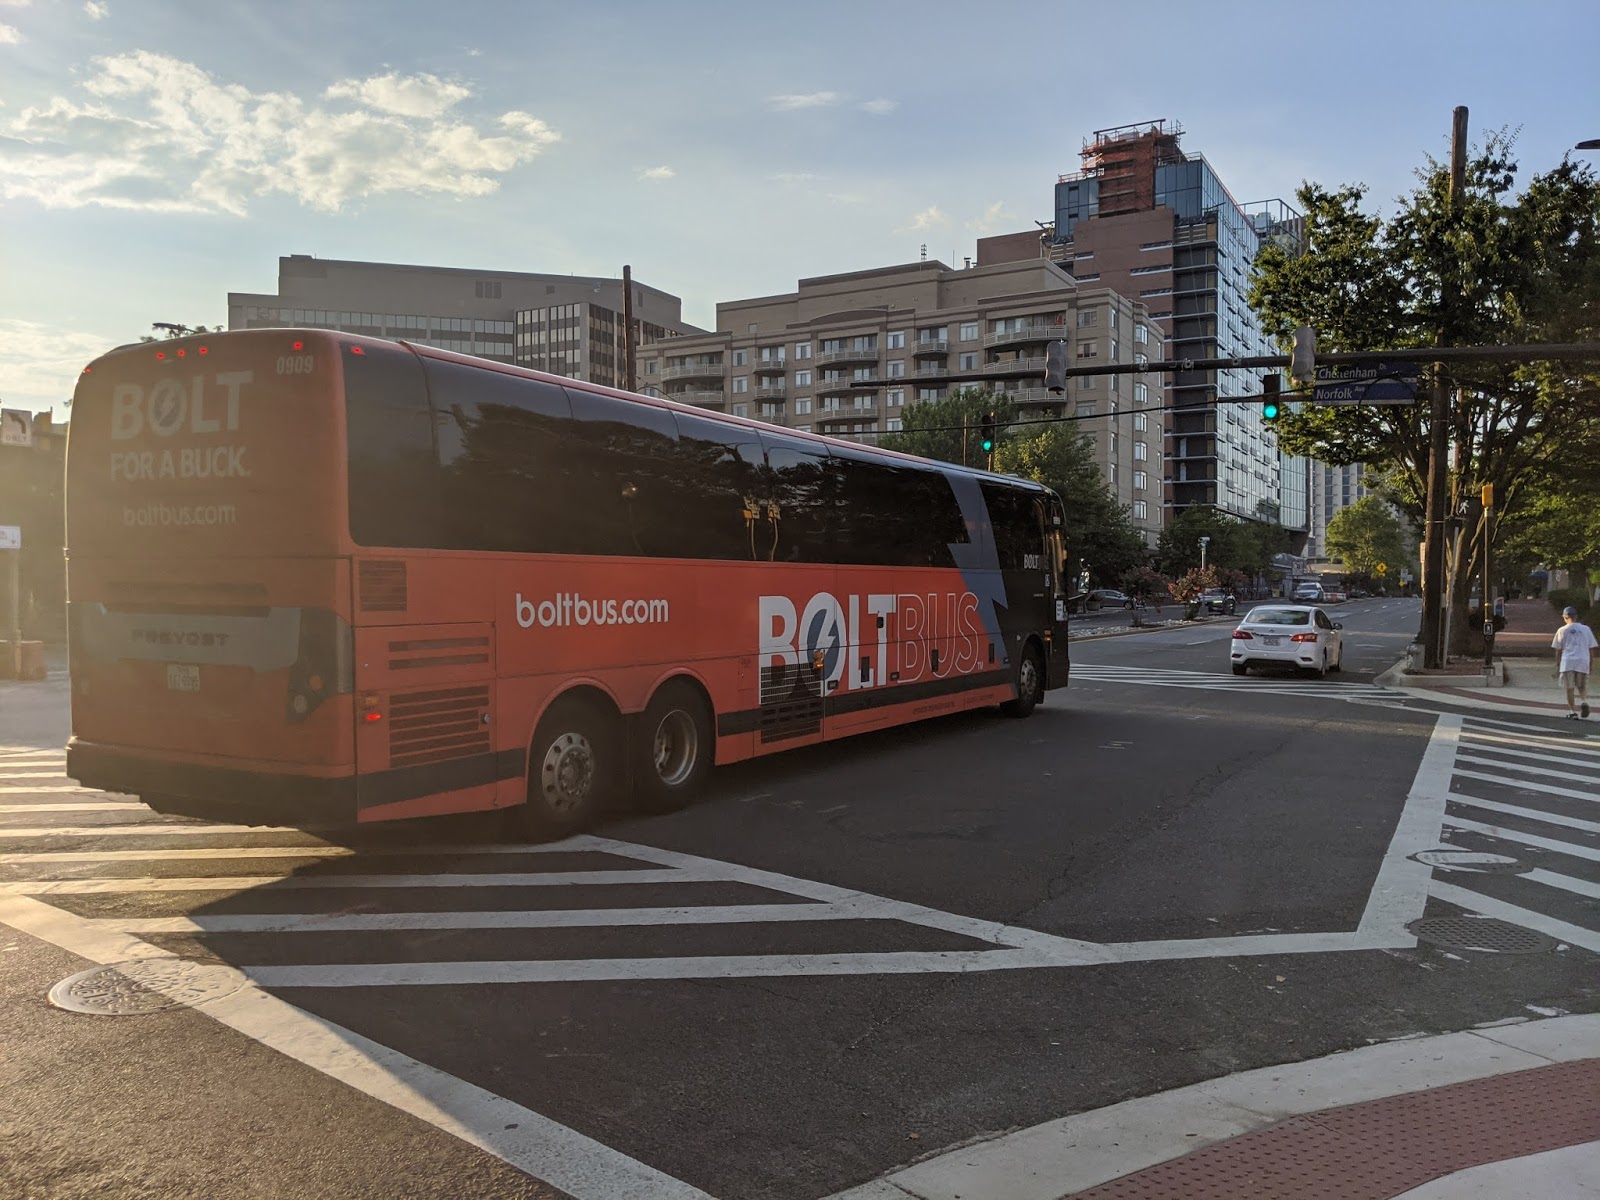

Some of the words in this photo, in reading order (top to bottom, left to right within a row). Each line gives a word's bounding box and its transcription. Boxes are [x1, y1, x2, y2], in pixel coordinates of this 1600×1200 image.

[276, 355, 314, 375] 0909
[111, 370, 254, 440] BOLT
[1316, 388, 1353, 400] Norfolk
[5, 434, 27, 443] ONLY
[111, 450, 155, 481] FOR
[159, 448, 176, 479] A
[181, 445, 250, 478] BUCK.
[122, 502, 238, 527] boltbus.com
[515, 593, 669, 628] boltbus.com
